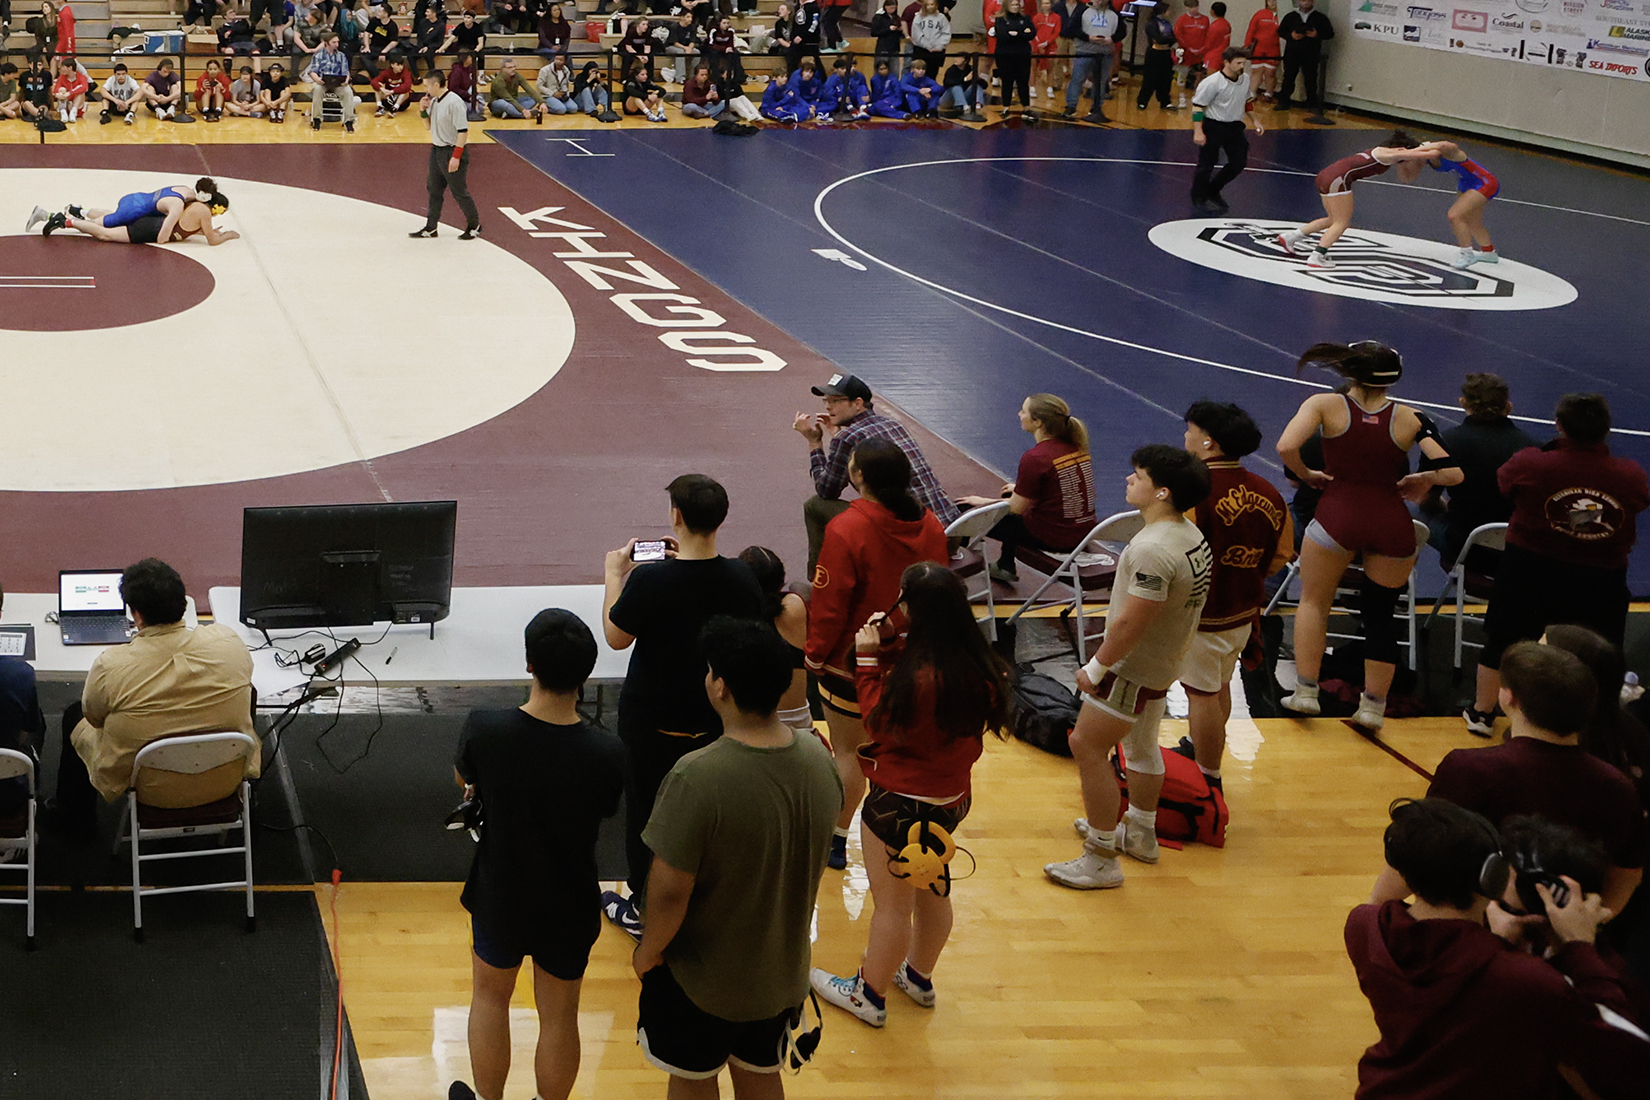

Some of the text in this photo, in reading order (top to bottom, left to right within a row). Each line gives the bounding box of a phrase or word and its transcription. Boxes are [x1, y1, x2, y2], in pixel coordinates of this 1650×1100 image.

[1492, 18, 1523, 29] Coastal
[1374, 25, 1399, 35] KPU
[1589, 61, 1604, 69] SEA
[497, 207, 788, 372] KINGS
